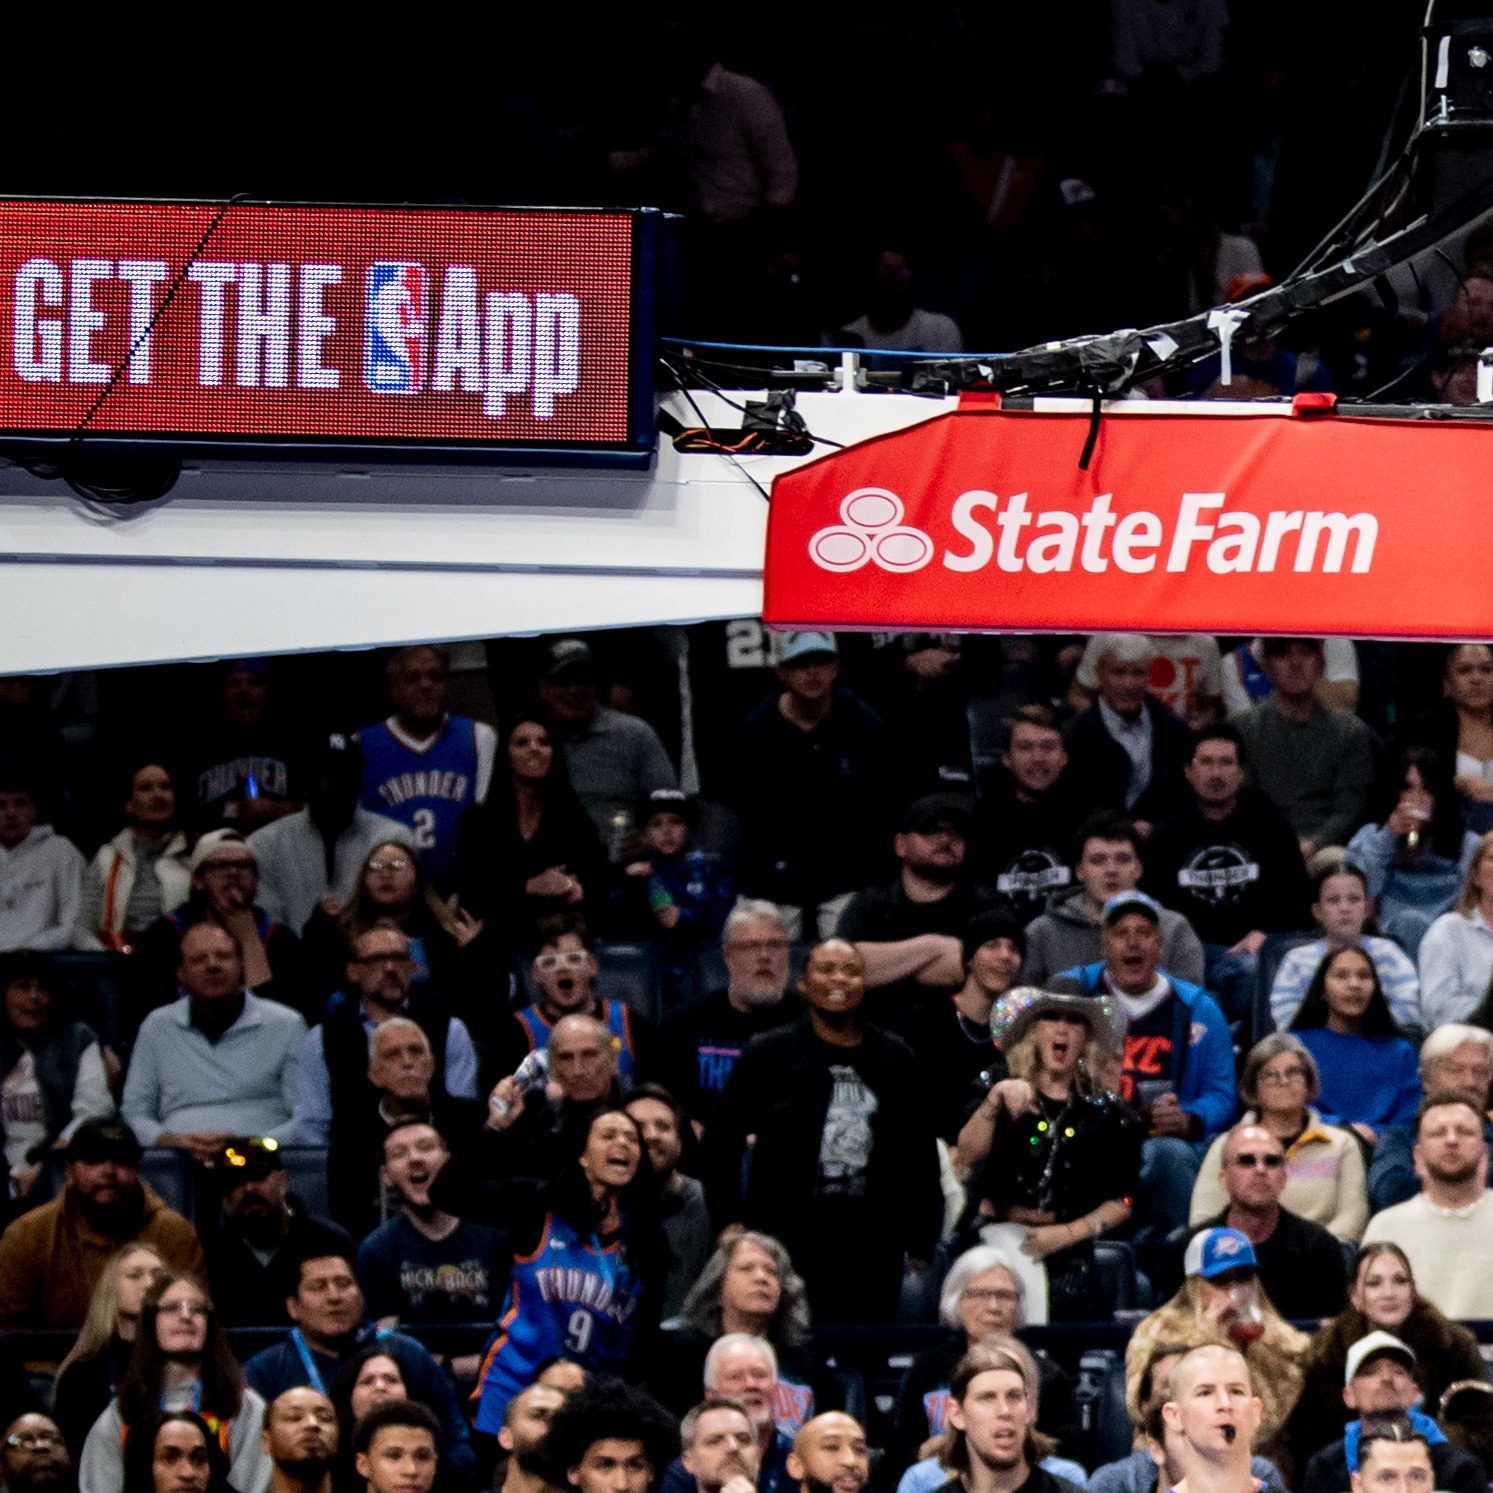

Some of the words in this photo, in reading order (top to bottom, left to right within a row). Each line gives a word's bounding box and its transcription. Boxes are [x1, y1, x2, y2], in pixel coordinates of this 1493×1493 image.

[13, 257, 170, 387] GET
[187, 259, 343, 389] THE
[431, 264, 582, 421] App
[944, 488, 1164, 575] State
[1166, 490, 1380, 575] Farm
[413, 808, 437, 849] 2
[1122, 1035, 1174, 1076] KC
[564, 1308, 594, 1354] 9
